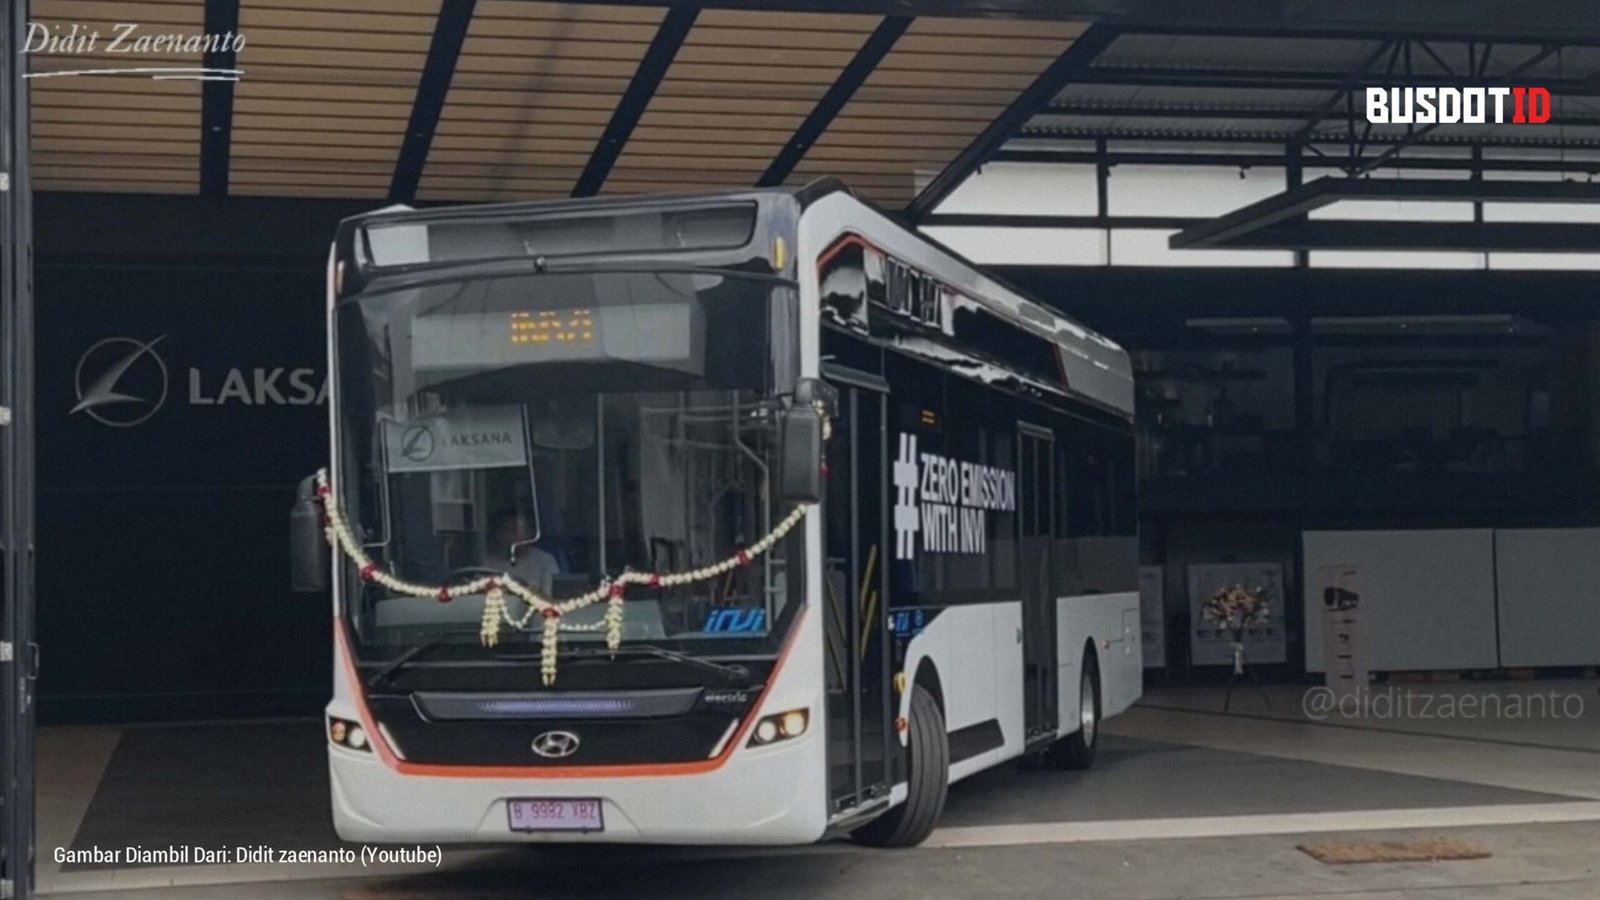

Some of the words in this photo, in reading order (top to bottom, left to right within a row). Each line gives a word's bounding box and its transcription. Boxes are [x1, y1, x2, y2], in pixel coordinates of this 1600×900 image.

[920, 452, 960, 505] ZERO
[960, 461, 1015, 512] EMISSION
[920, 501, 959, 553] WITH
[959, 506, 986, 554] INVI
[513, 801, 524, 819] B
